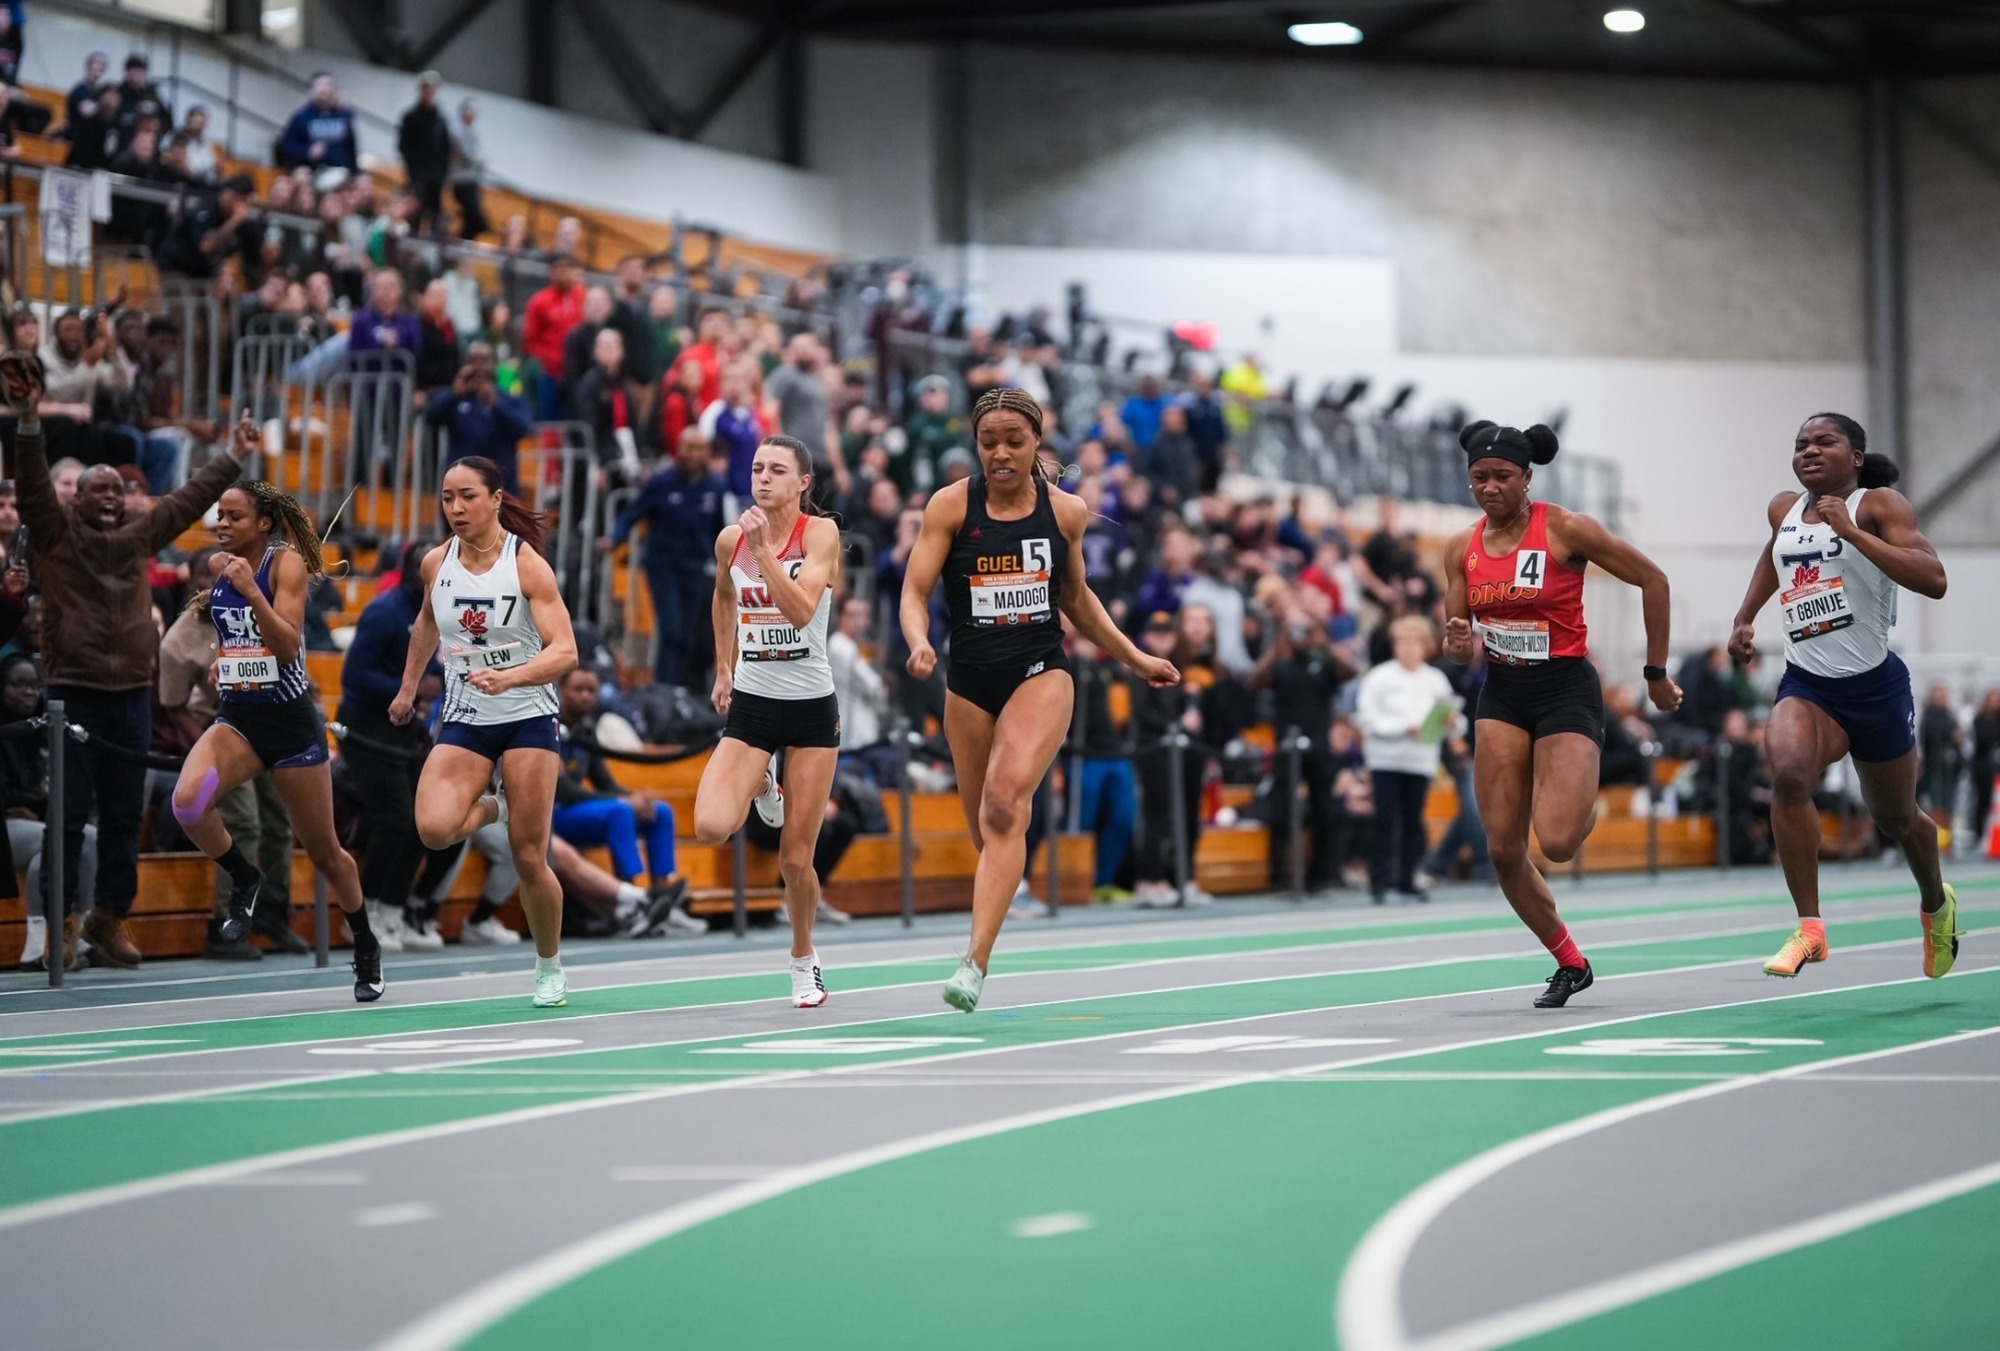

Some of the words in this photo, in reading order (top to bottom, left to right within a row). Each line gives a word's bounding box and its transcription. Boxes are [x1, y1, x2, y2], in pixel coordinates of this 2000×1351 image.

[977, 555, 1021, 572] GUEL
[1030, 541, 1046, 572] 5
[1520, 552, 1540, 585] 4
[502, 595, 517, 626] 7
[994, 586, 1047, 610] MADOGO
[1796, 592, 1846, 621] GBINIJE
[761, 628, 801, 645] LEDUC
[237, 661, 269, 677] OGOR
[483, 648, 511, 667] LEW
[812, 965, 826, 993] AIR
